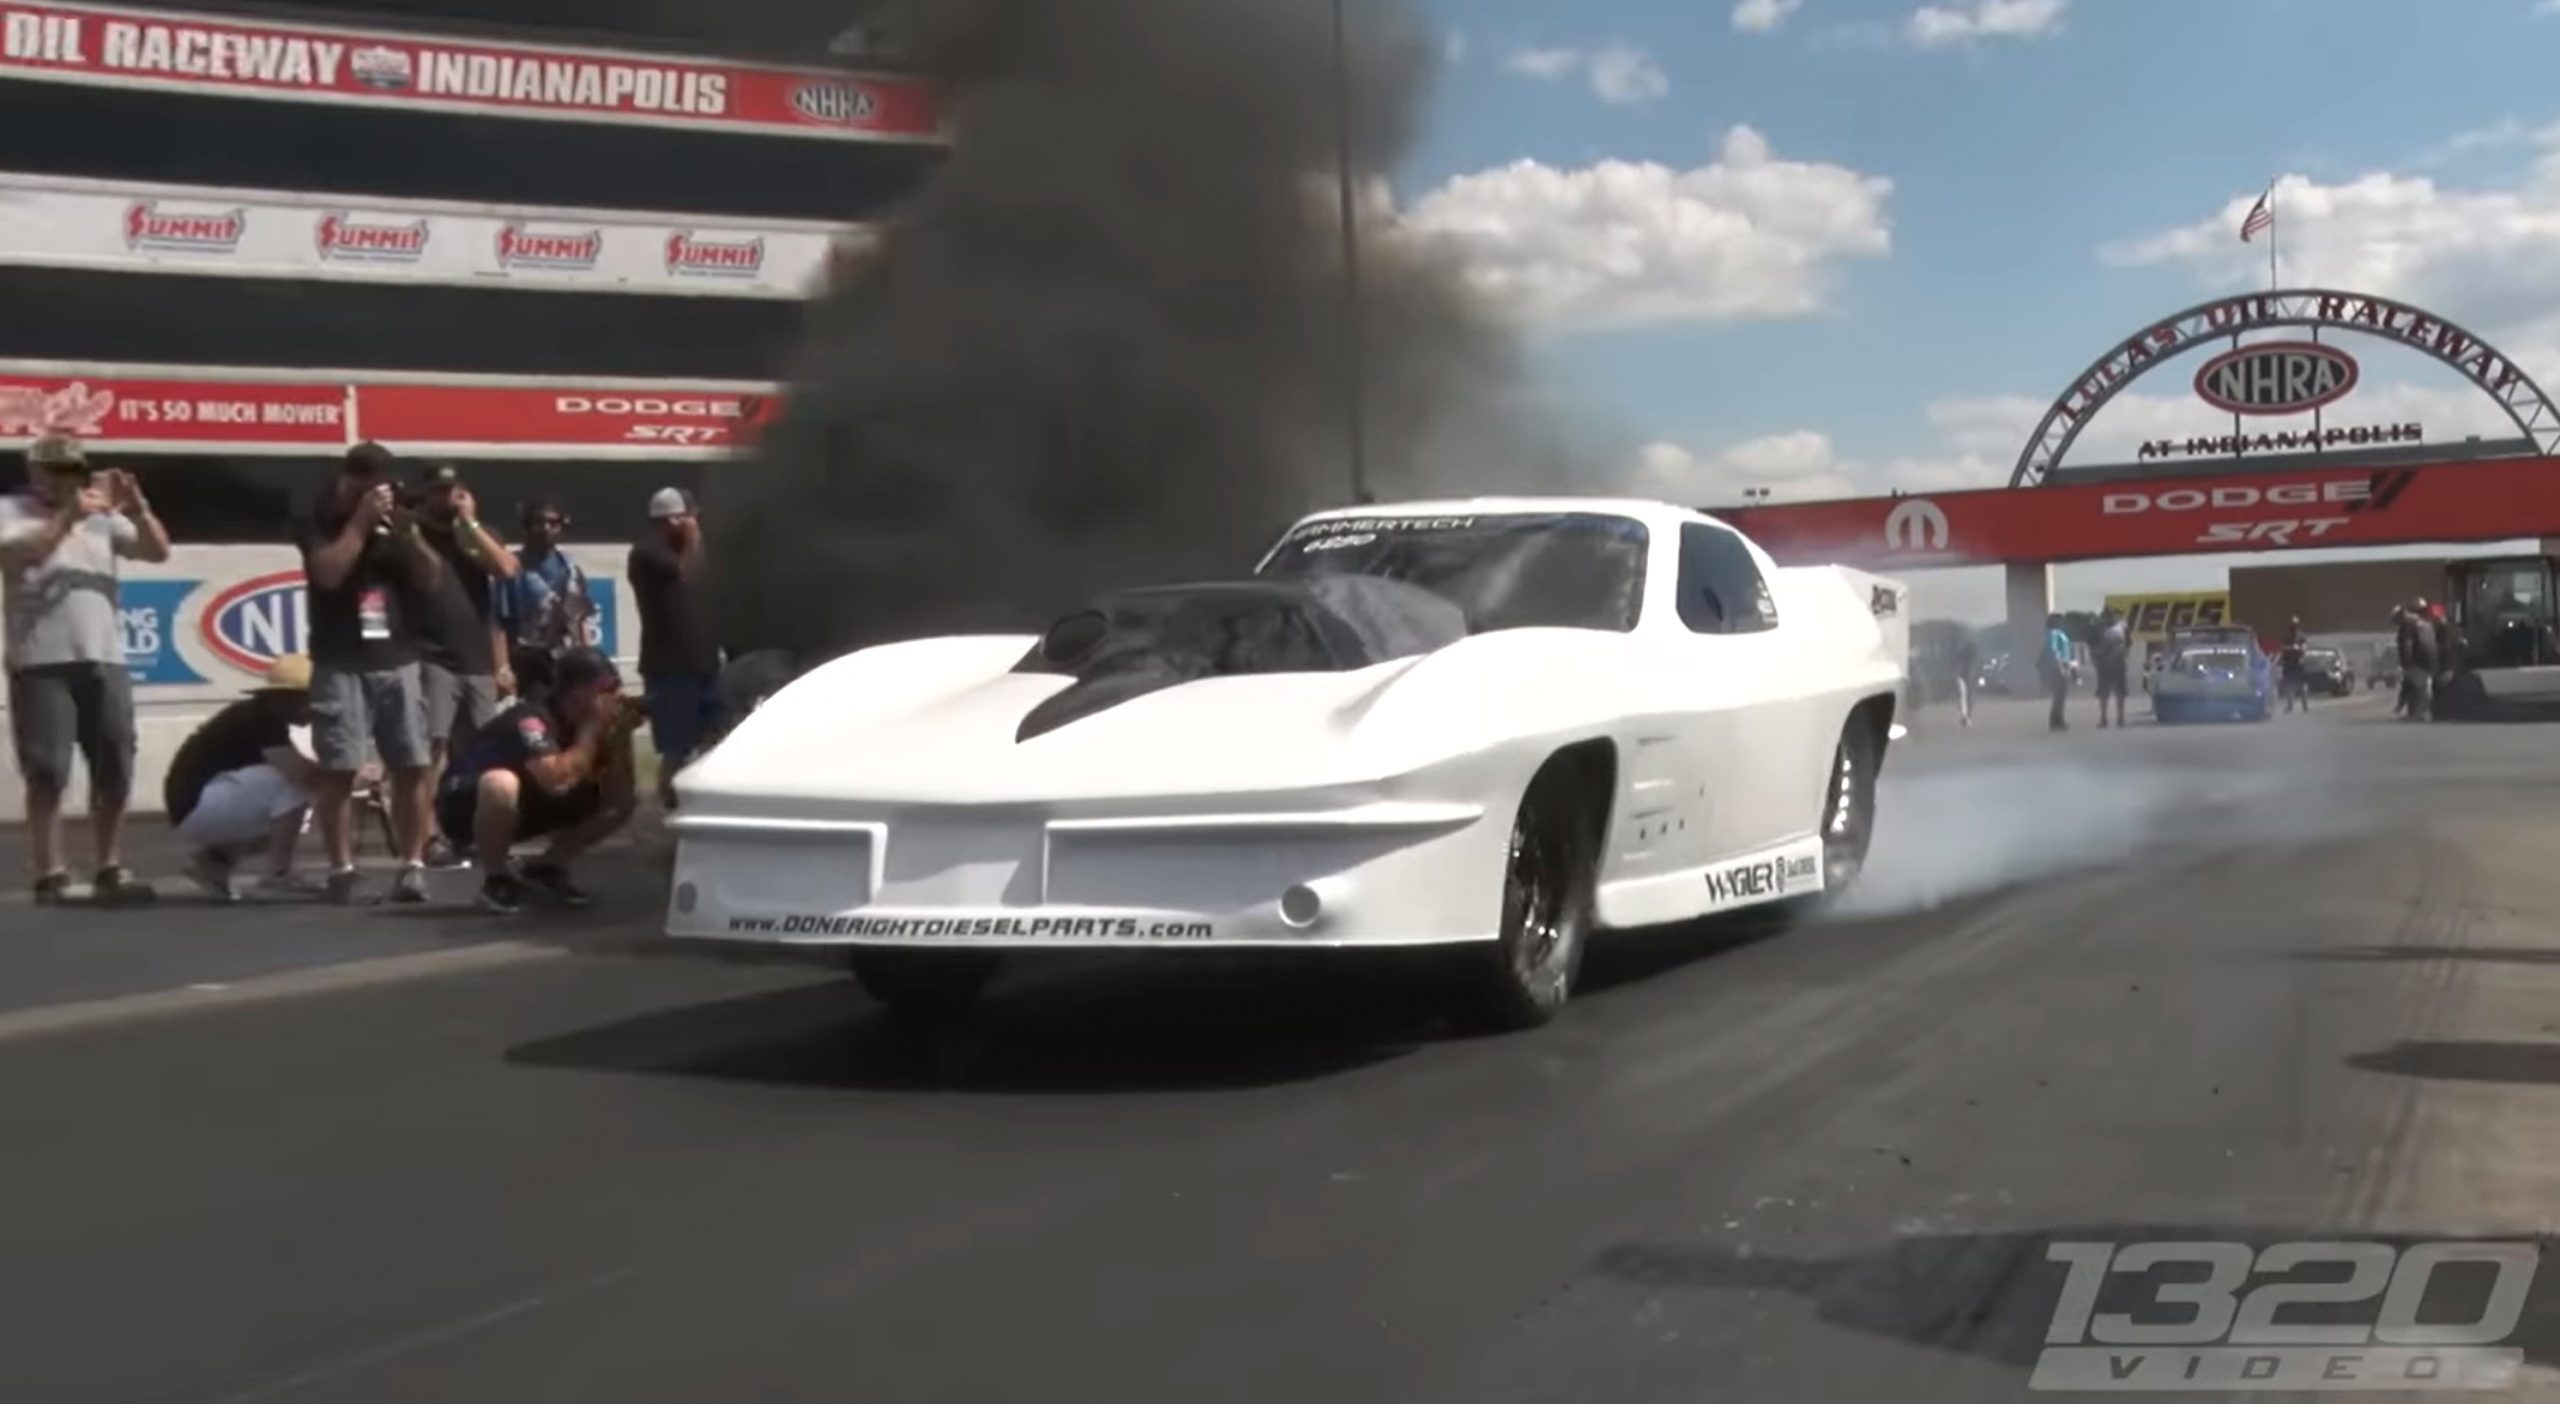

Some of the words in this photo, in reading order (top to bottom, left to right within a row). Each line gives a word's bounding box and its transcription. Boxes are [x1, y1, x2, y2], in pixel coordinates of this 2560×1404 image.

[104, 21, 345, 86] RACEWAY
[417, 51, 726, 115] INDIANAPOLIS
[801, 86, 873, 118] NHRA
[2317, 293, 2523, 391] RACEWAY
[2218, 352, 2336, 404] NHRA
[119, 400, 159, 421] IT'S
[162, 401, 193, 421] SO
[197, 402, 257, 422] MUCH
[556, 397, 741, 416] DODGE
[624, 415, 728, 443] SRT
[2138, 440, 2173, 459] AT
[2186, 422, 2423, 457] INDIANAPOLIS
[2103, 479, 2372, 514] DODGE
[2196, 517, 2350, 545] SRT
